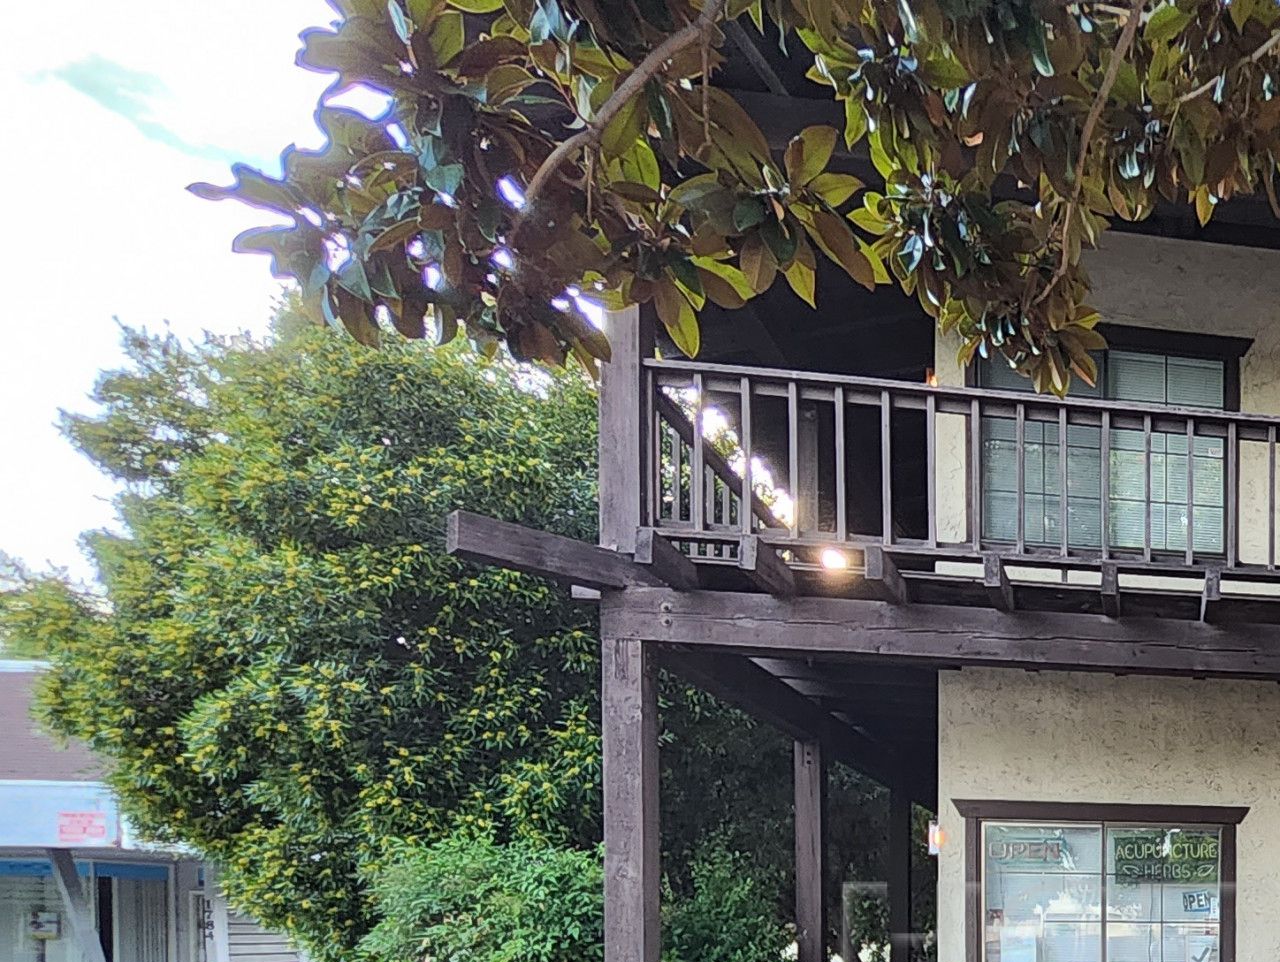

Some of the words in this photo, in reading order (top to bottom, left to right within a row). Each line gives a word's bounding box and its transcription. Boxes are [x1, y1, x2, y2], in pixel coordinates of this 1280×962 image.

[989, 842, 1061, 860] OPEN
[1144, 863, 1191, 879] HERBS
[1183, 892, 1210, 910] OPEN
